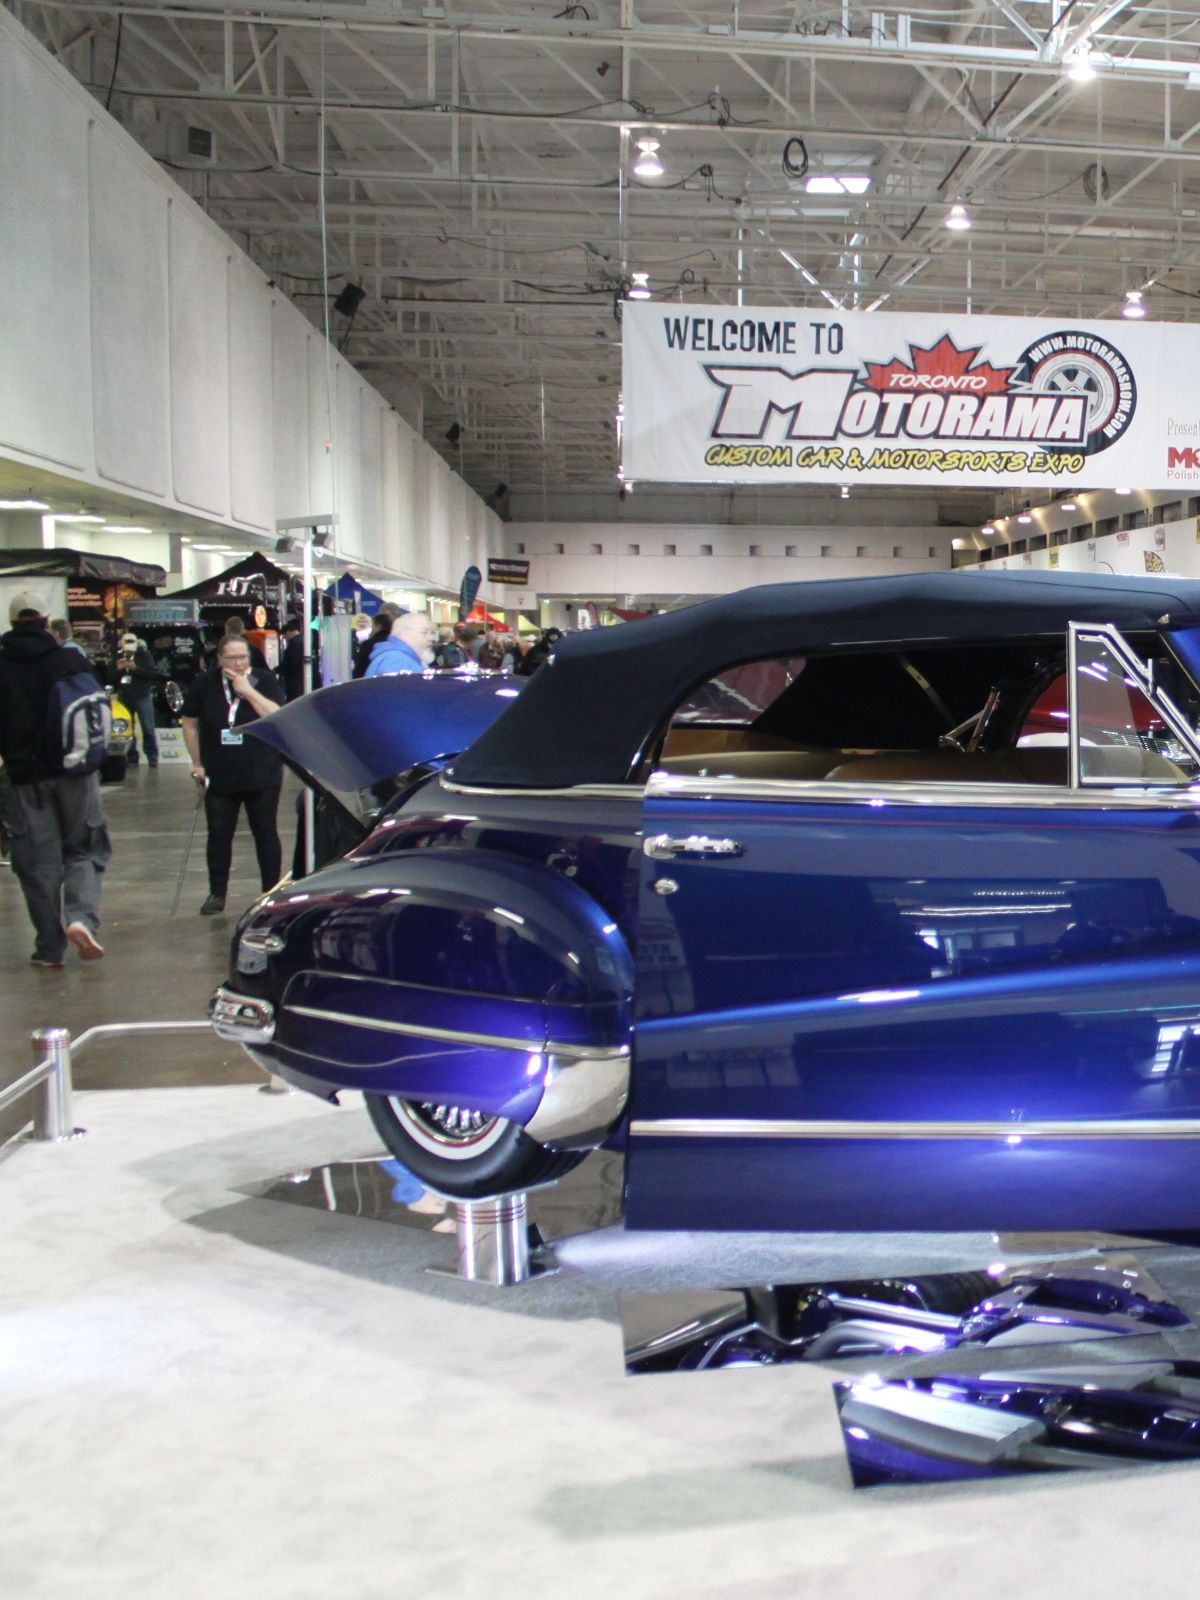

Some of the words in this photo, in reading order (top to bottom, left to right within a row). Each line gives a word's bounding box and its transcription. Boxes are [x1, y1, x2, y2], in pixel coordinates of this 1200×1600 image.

[664, 316, 796, 354] WELCOME
[810, 322, 844, 355] TO
[889, 373, 988, 390] TORONTO
[703, 364, 1089, 442] MOTORAMA
[704, 444, 793, 467] CUSTOM
[796, 446, 847, 470] CAR
[847, 448, 864, 471] &
[866, 448, 1028, 473] MOTORSPORTS
[1027, 451, 1086, 475] EXPO
